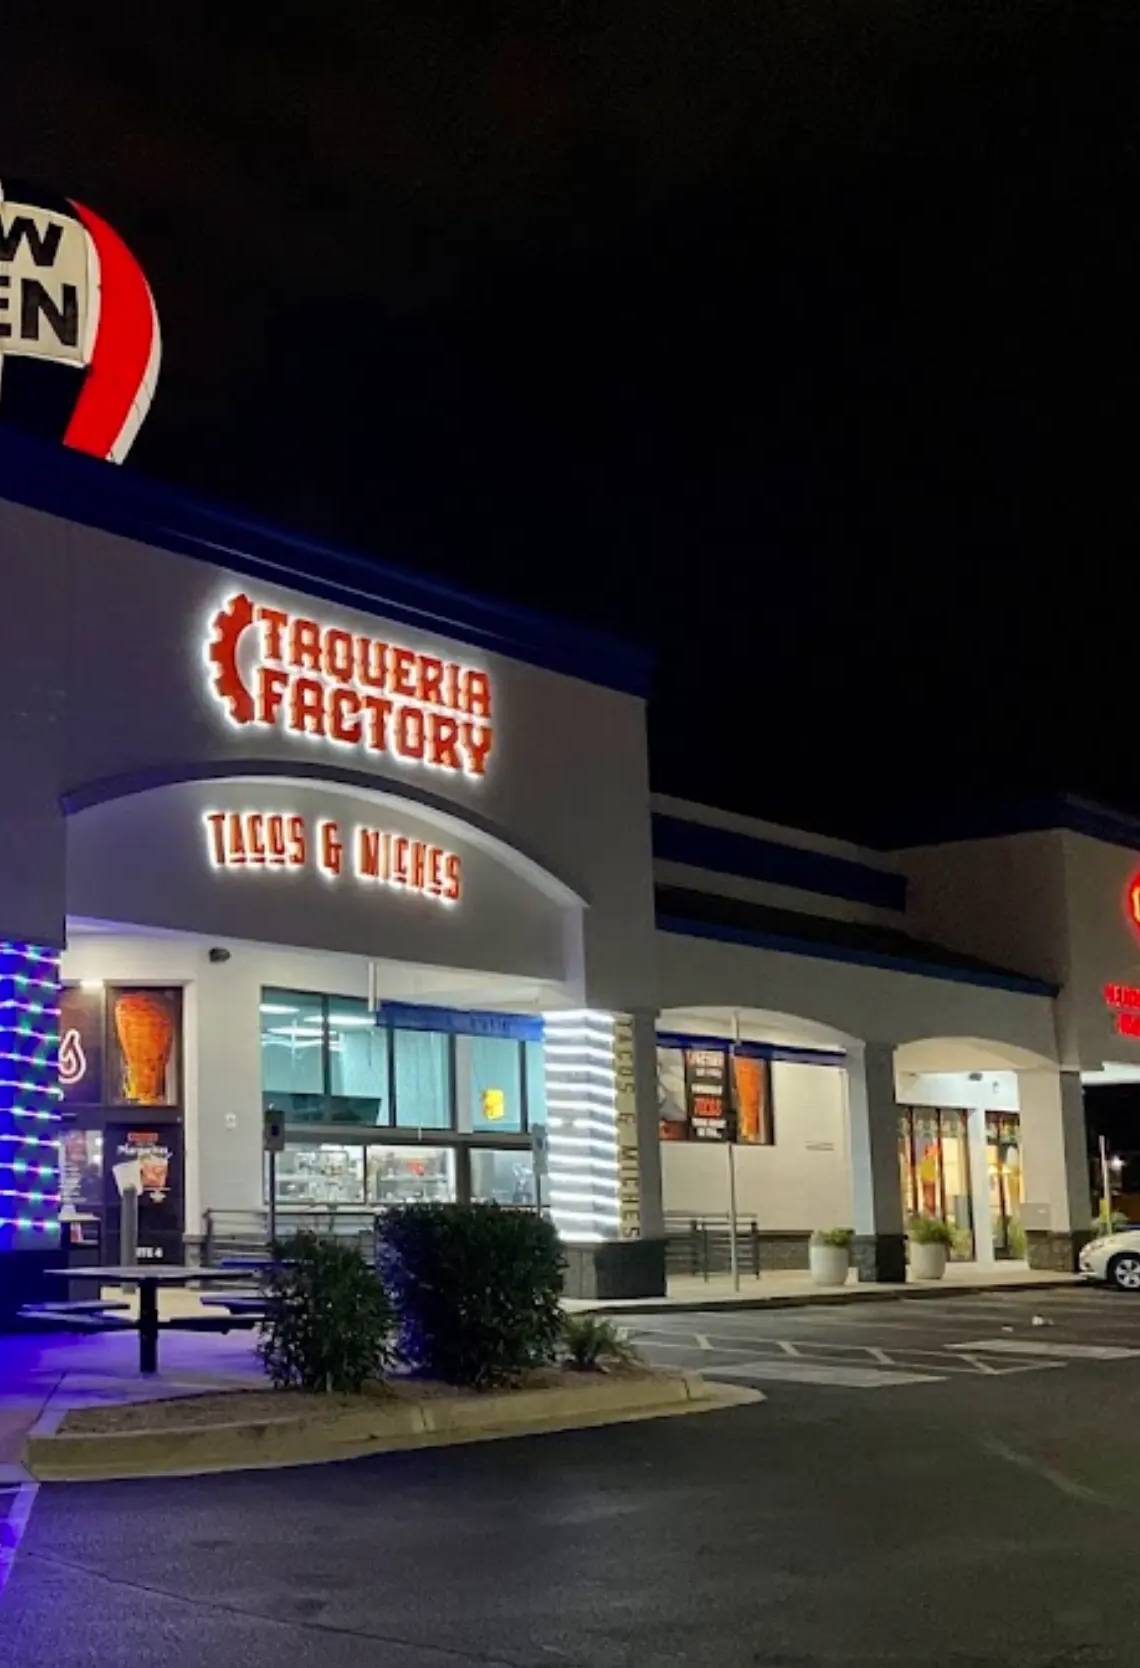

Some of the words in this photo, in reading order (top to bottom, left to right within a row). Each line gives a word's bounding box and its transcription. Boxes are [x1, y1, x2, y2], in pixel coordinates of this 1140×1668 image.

[258, 607, 492, 718] TAQUERIA
[257, 667, 493, 776] FACTORY
[207, 812, 306, 865] TACOS
[321, 822, 342, 875] &
